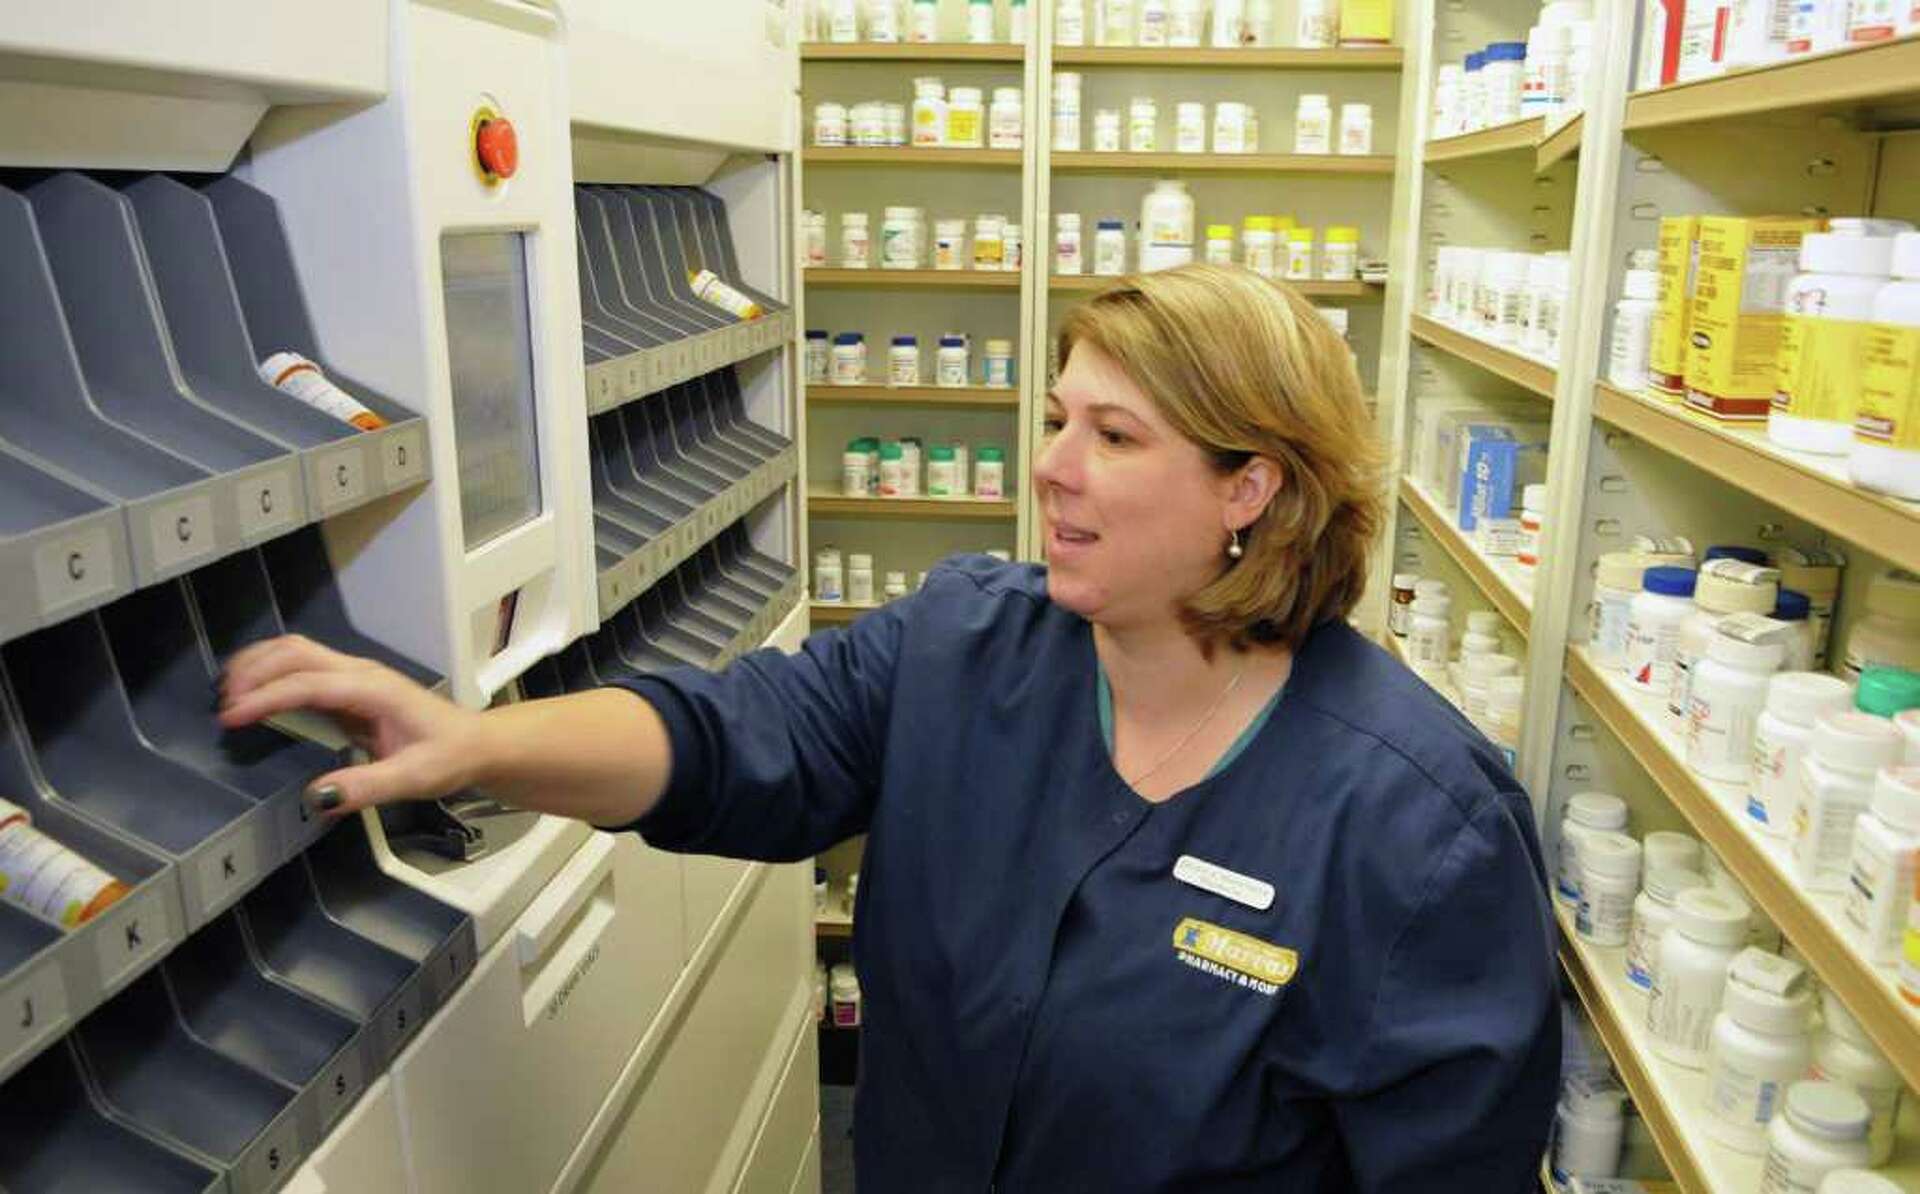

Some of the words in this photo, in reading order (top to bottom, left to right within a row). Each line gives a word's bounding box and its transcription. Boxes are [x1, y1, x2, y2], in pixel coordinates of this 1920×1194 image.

[336, 465, 347, 487] C
[260, 488, 272, 513] C
[176, 515, 192, 542] C
[67, 552, 85, 581] C
[222, 853, 235, 879] K
[125, 920, 142, 950] K
[20, 1000, 34, 1027] J
[335, 1074, 346, 1096] S
[269, 1147, 280, 1171] S
